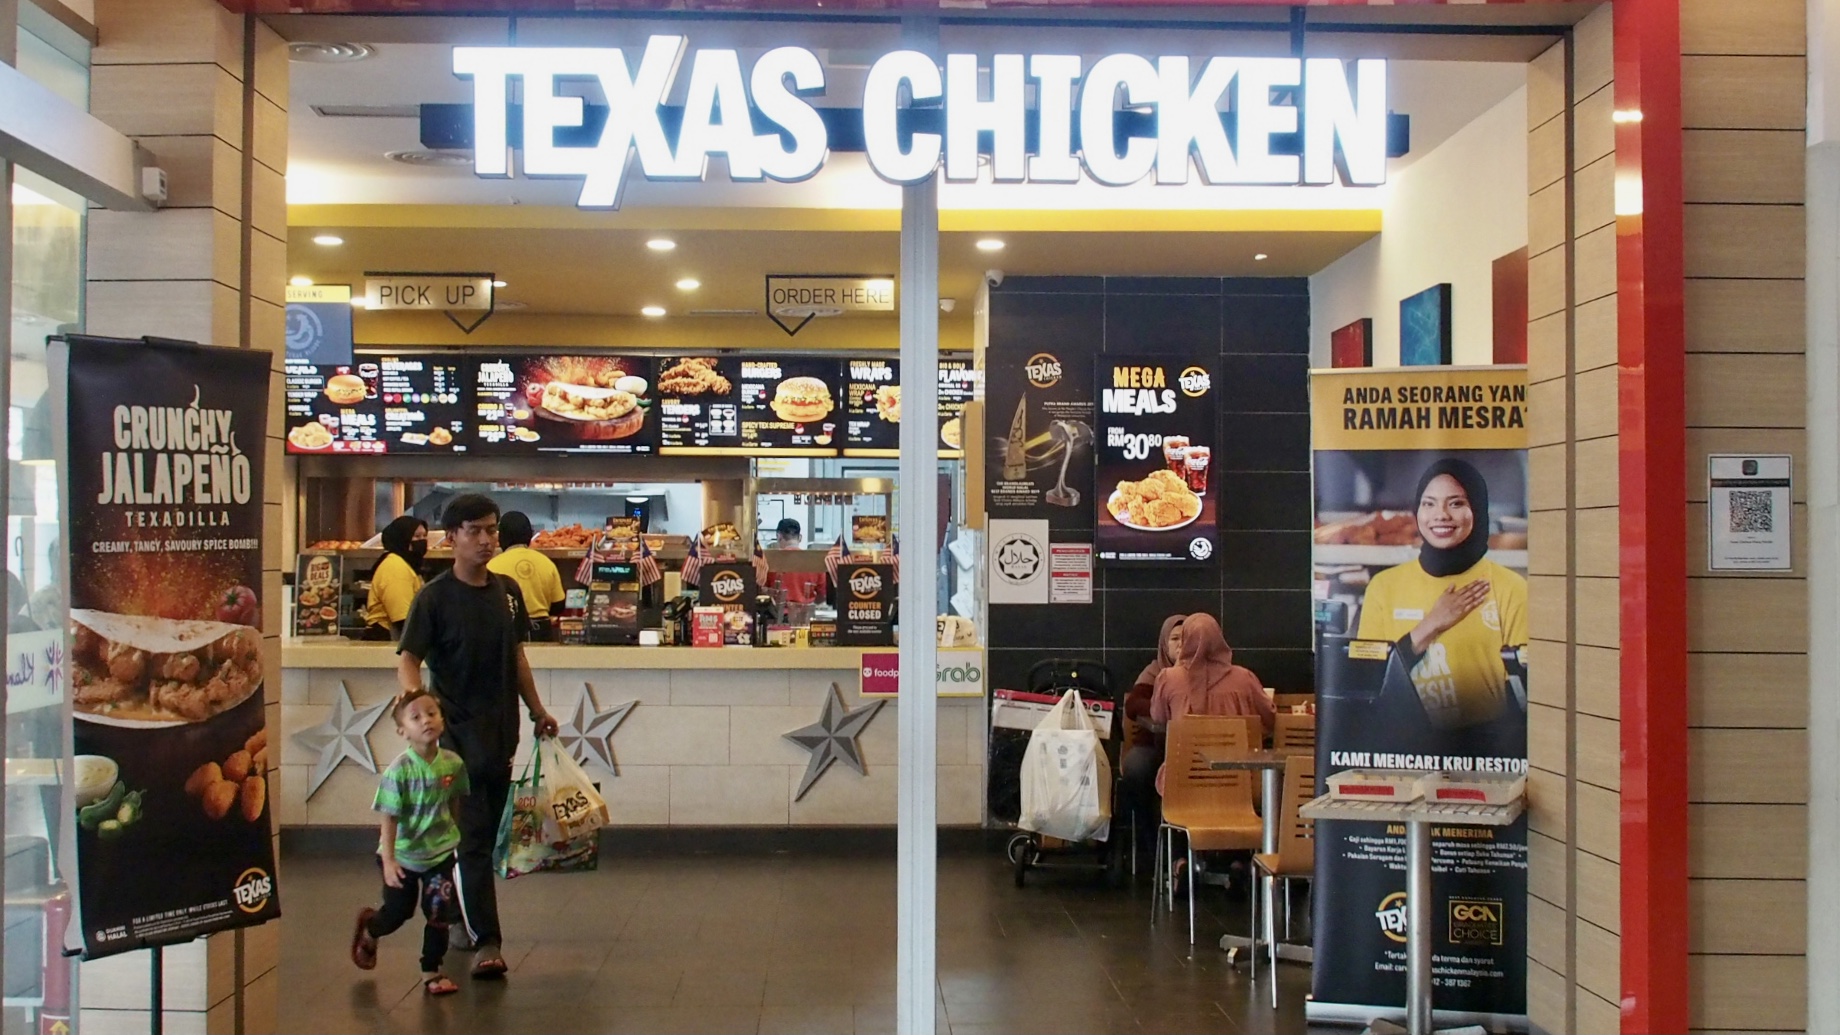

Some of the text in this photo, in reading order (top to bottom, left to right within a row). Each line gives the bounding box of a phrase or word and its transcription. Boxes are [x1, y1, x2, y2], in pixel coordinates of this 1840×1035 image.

[452, 34, 1388, 210] TEXAS CHICKEN
[288, 290, 323, 298] SERVING
[380, 285, 475, 304] PICK UP
[773, 288, 889, 304] ORDER HERE
[742, 368, 782, 379] BURGERS
[850, 367, 892, 382] WRAPS
[1024, 362, 1062, 381] TEXAS
[1113, 366, 1166, 388] MEGA
[1178, 374, 1211, 391] TEXAS
[1102, 388, 1176, 416] MEALS
[1343, 384, 1528, 404] ANDA SEORANG YAN
[661, 404, 701, 416] TENDERS
[1344, 406, 1528, 430] RAMAH MESRA
[114, 405, 232, 451] CRUNCHY
[98, 444, 251, 504] JALAPEÑO
[125, 511, 230, 528] TEXADILLA
[92, 541, 133, 553] CREAMY,
[134, 540, 164, 552] TANGY,
[164, 539, 201, 551] SAVOURY
[204, 538, 228, 550] SPICE
[1004, 549, 1033, 565] حلال
[311, 571, 329, 580] DEALS
[711, 578, 744, 595] TEXAS
[849, 576, 882, 593] TEXAS
[848, 610, 881, 620] CLOSED
[874, 667, 899, 678] foodp
[1330, 751, 1528, 773] KAMI MENCARI KRU RESTOR
[552, 790, 589, 820] EXAS
[1386, 824, 1406, 834] AND
[1442, 827, 1493, 839] MENERIMA
[1360, 836, 1384, 845] sehingga
[1369, 853, 1393, 862] Seragam
[1511, 860, 1528, 868] Pangk
[233, 876, 272, 904] TEXAS
[1375, 906, 1407, 932] TEX
[1454, 904, 1497, 922] GCA
[107, 931, 128, 940] HALAL
[1453, 928, 1498, 940] CHOICE
